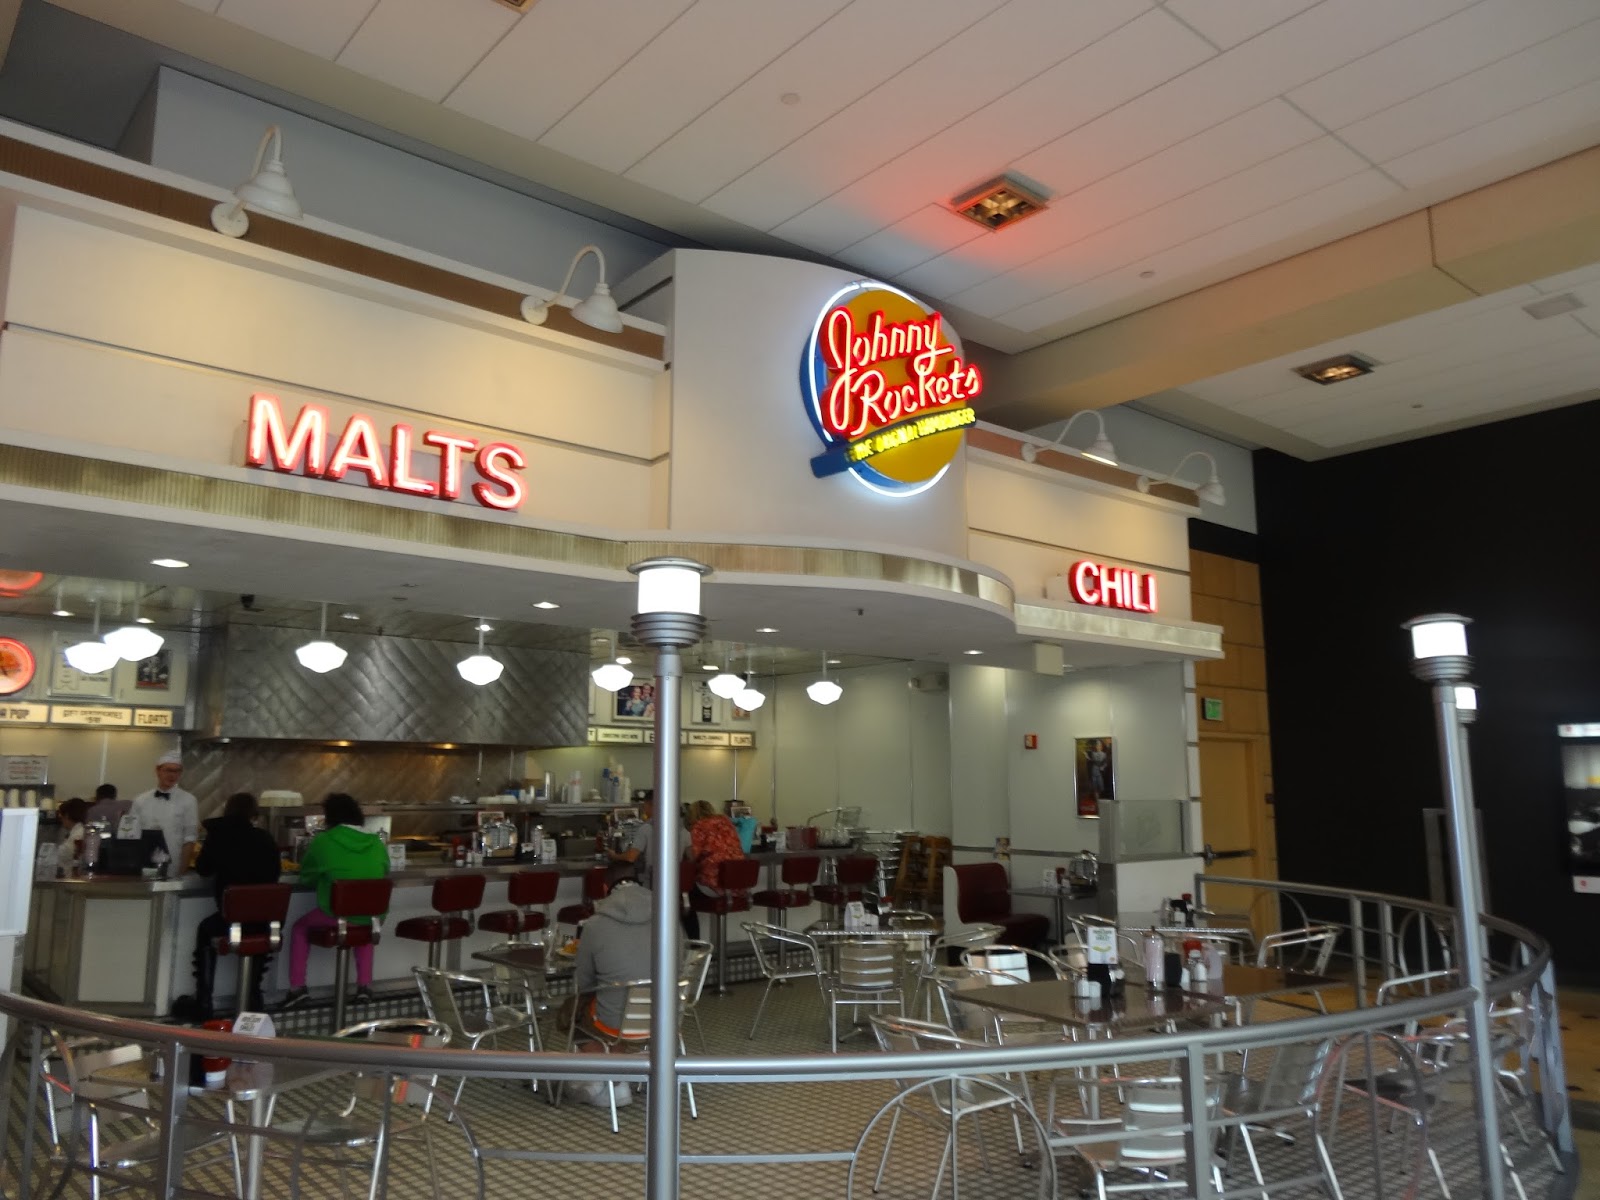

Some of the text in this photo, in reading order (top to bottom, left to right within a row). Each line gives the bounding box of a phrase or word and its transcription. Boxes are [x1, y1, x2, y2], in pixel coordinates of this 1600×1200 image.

[821, 306, 956, 433] Johnny
[246, 392, 529, 511] MALTS
[1067, 559, 1158, 614] CHILI
[138, 713, 169, 725] FLOATS
